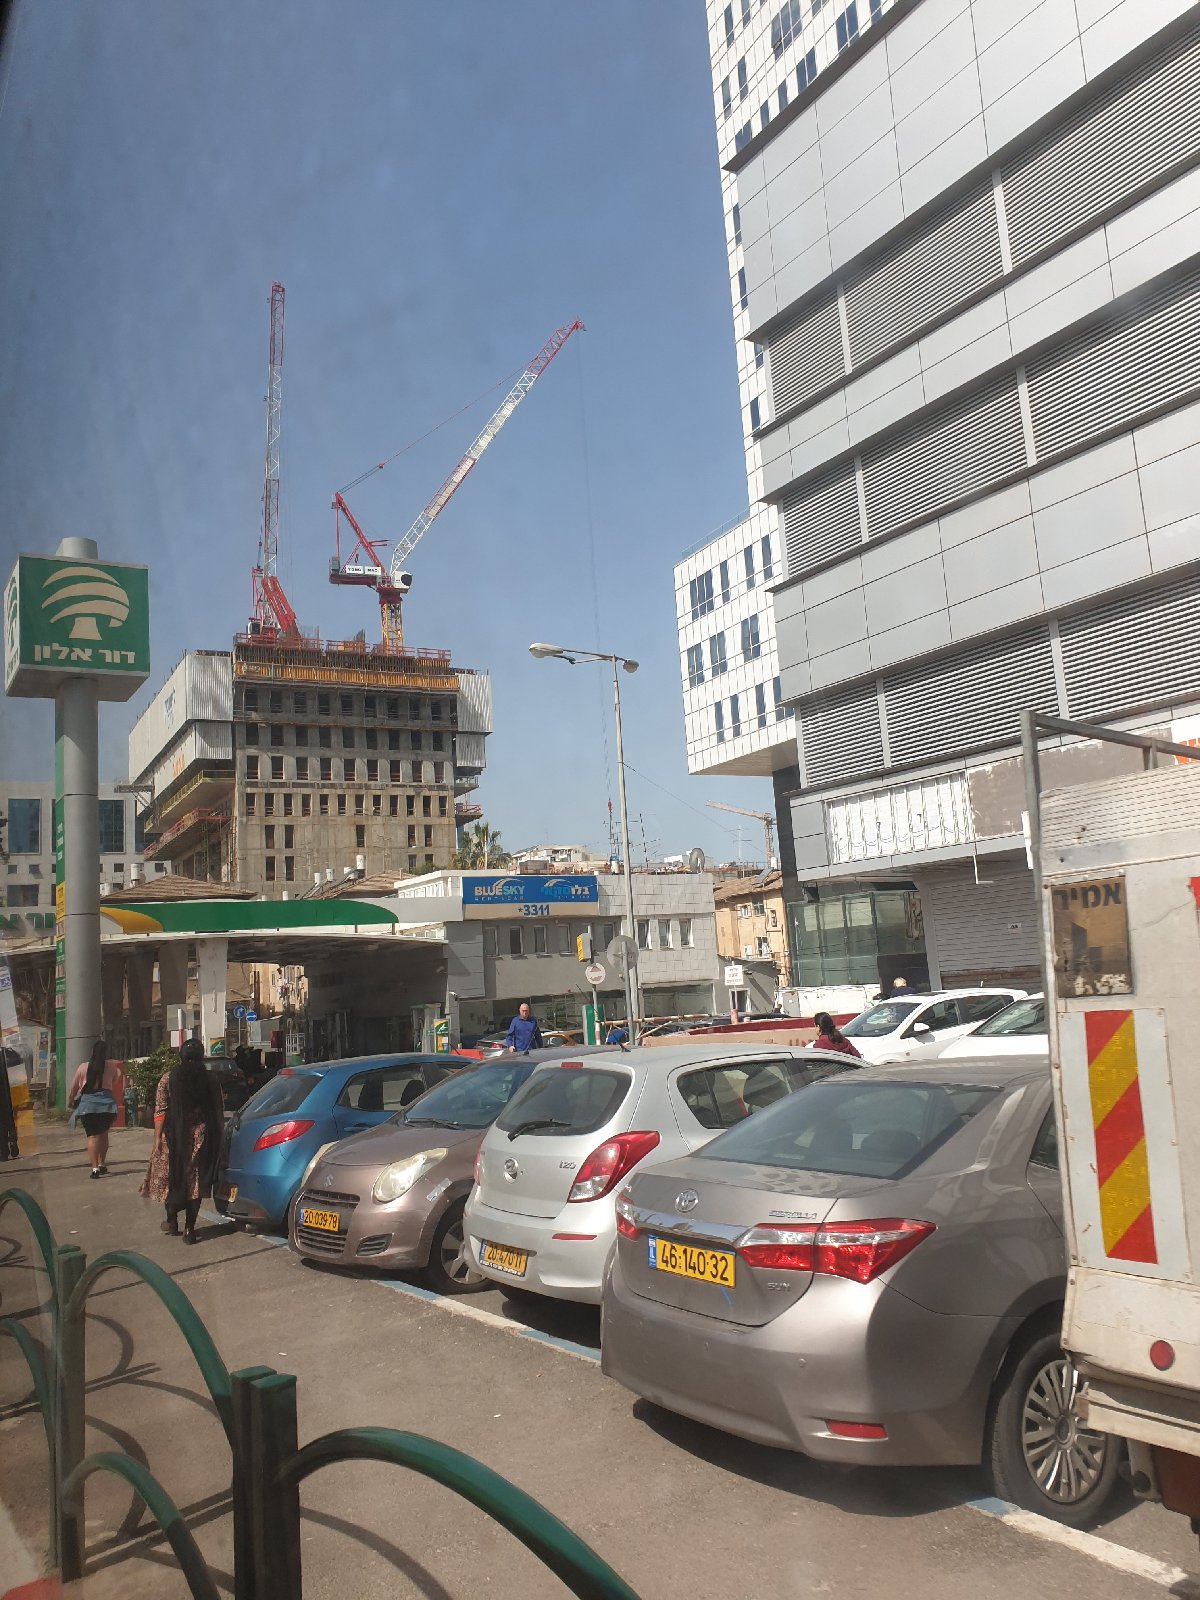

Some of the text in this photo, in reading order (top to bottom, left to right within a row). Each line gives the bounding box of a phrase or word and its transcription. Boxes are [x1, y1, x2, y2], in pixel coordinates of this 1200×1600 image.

[34, 643, 136, 664] דור אלון
[474, 885, 526, 896] BLUESKY
[1053, 882, 1122, 911] אמיר
